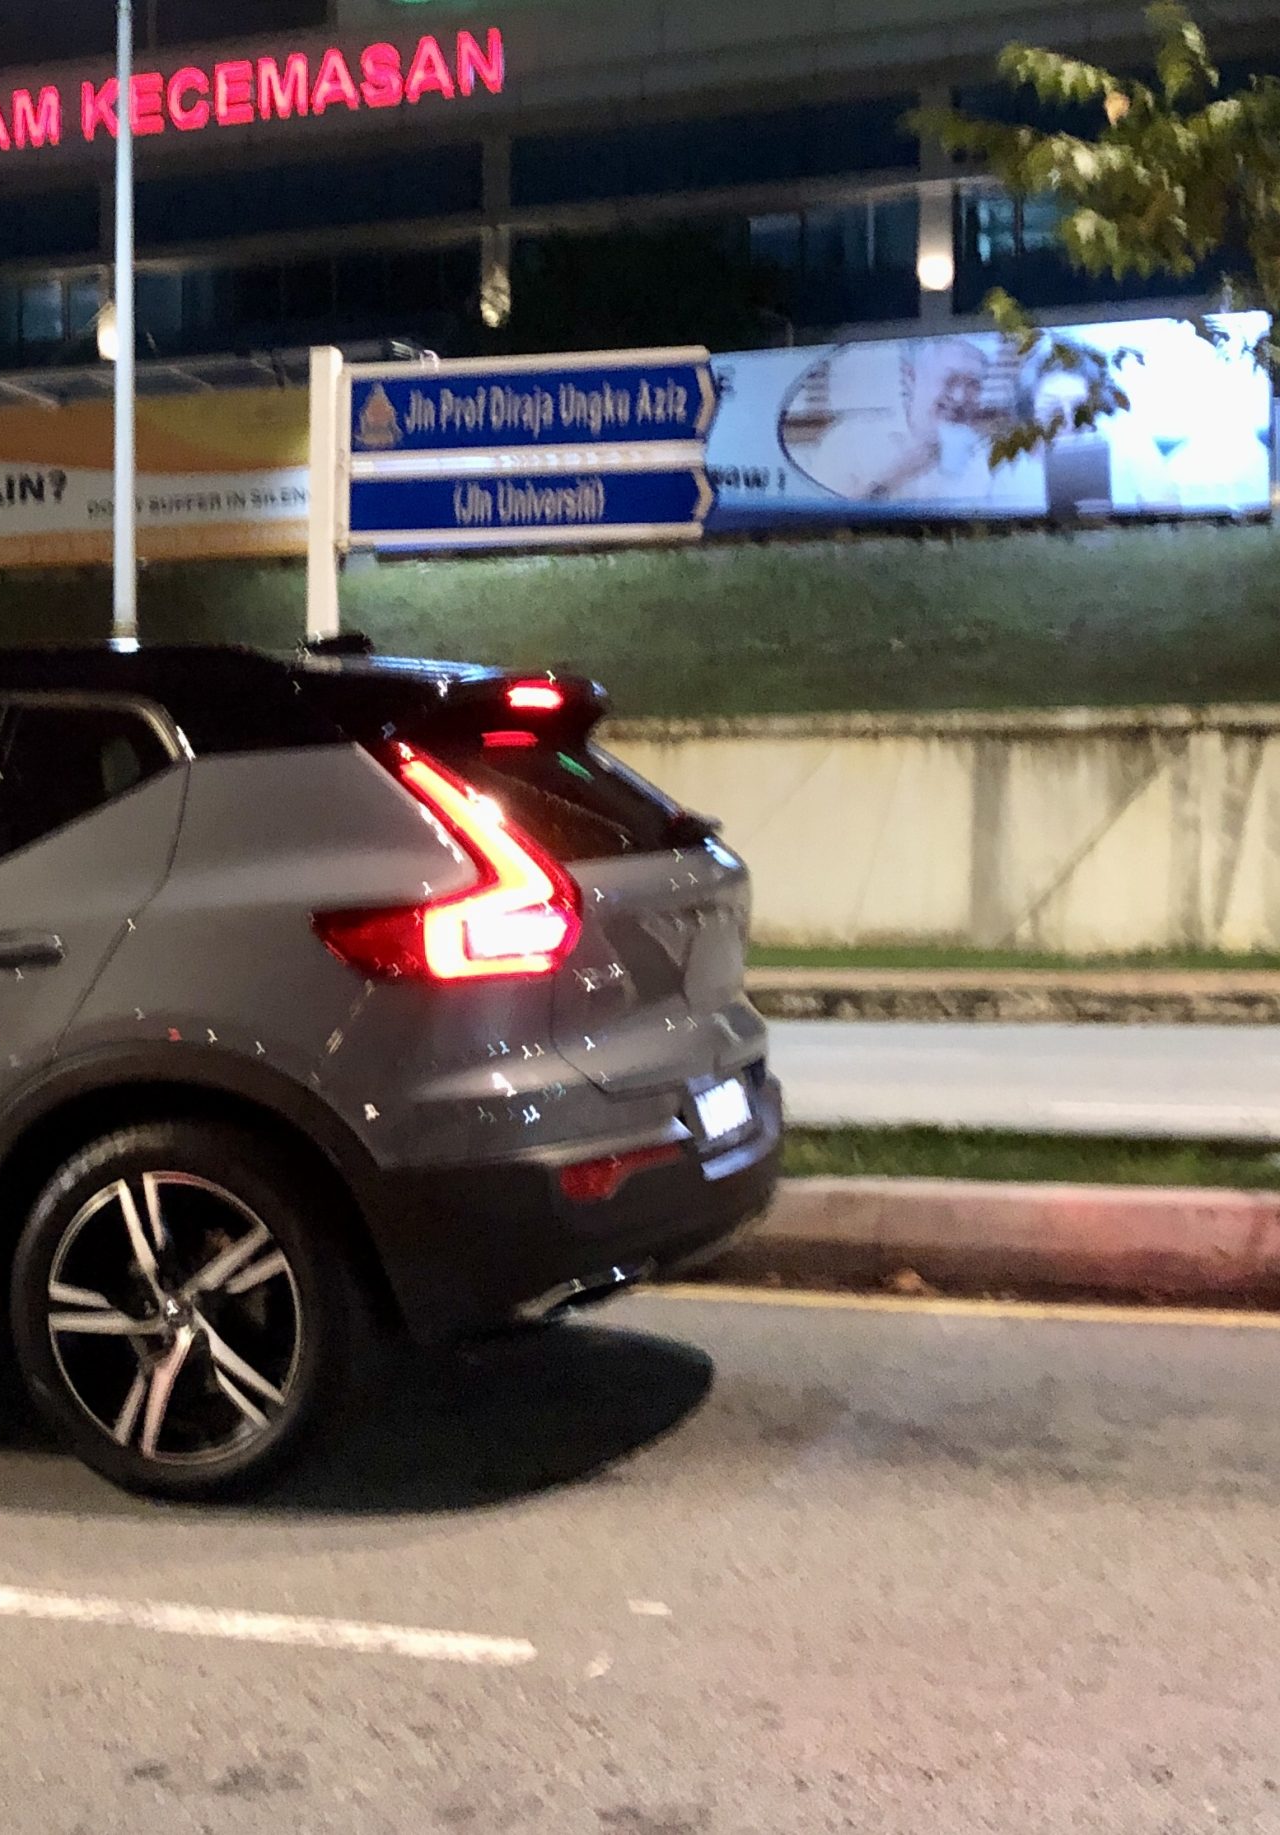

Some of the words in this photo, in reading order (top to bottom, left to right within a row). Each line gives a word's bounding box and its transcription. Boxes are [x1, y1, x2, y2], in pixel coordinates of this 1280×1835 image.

[81, 27, 506, 140] KECEMASAN
[405, 388, 435, 434] Jln
[440, 386, 486, 433] Prof
[490, 384, 554, 438] Diraja
[560, 381, 630, 436] Ungku
[637, 377, 688, 424] Aziz
